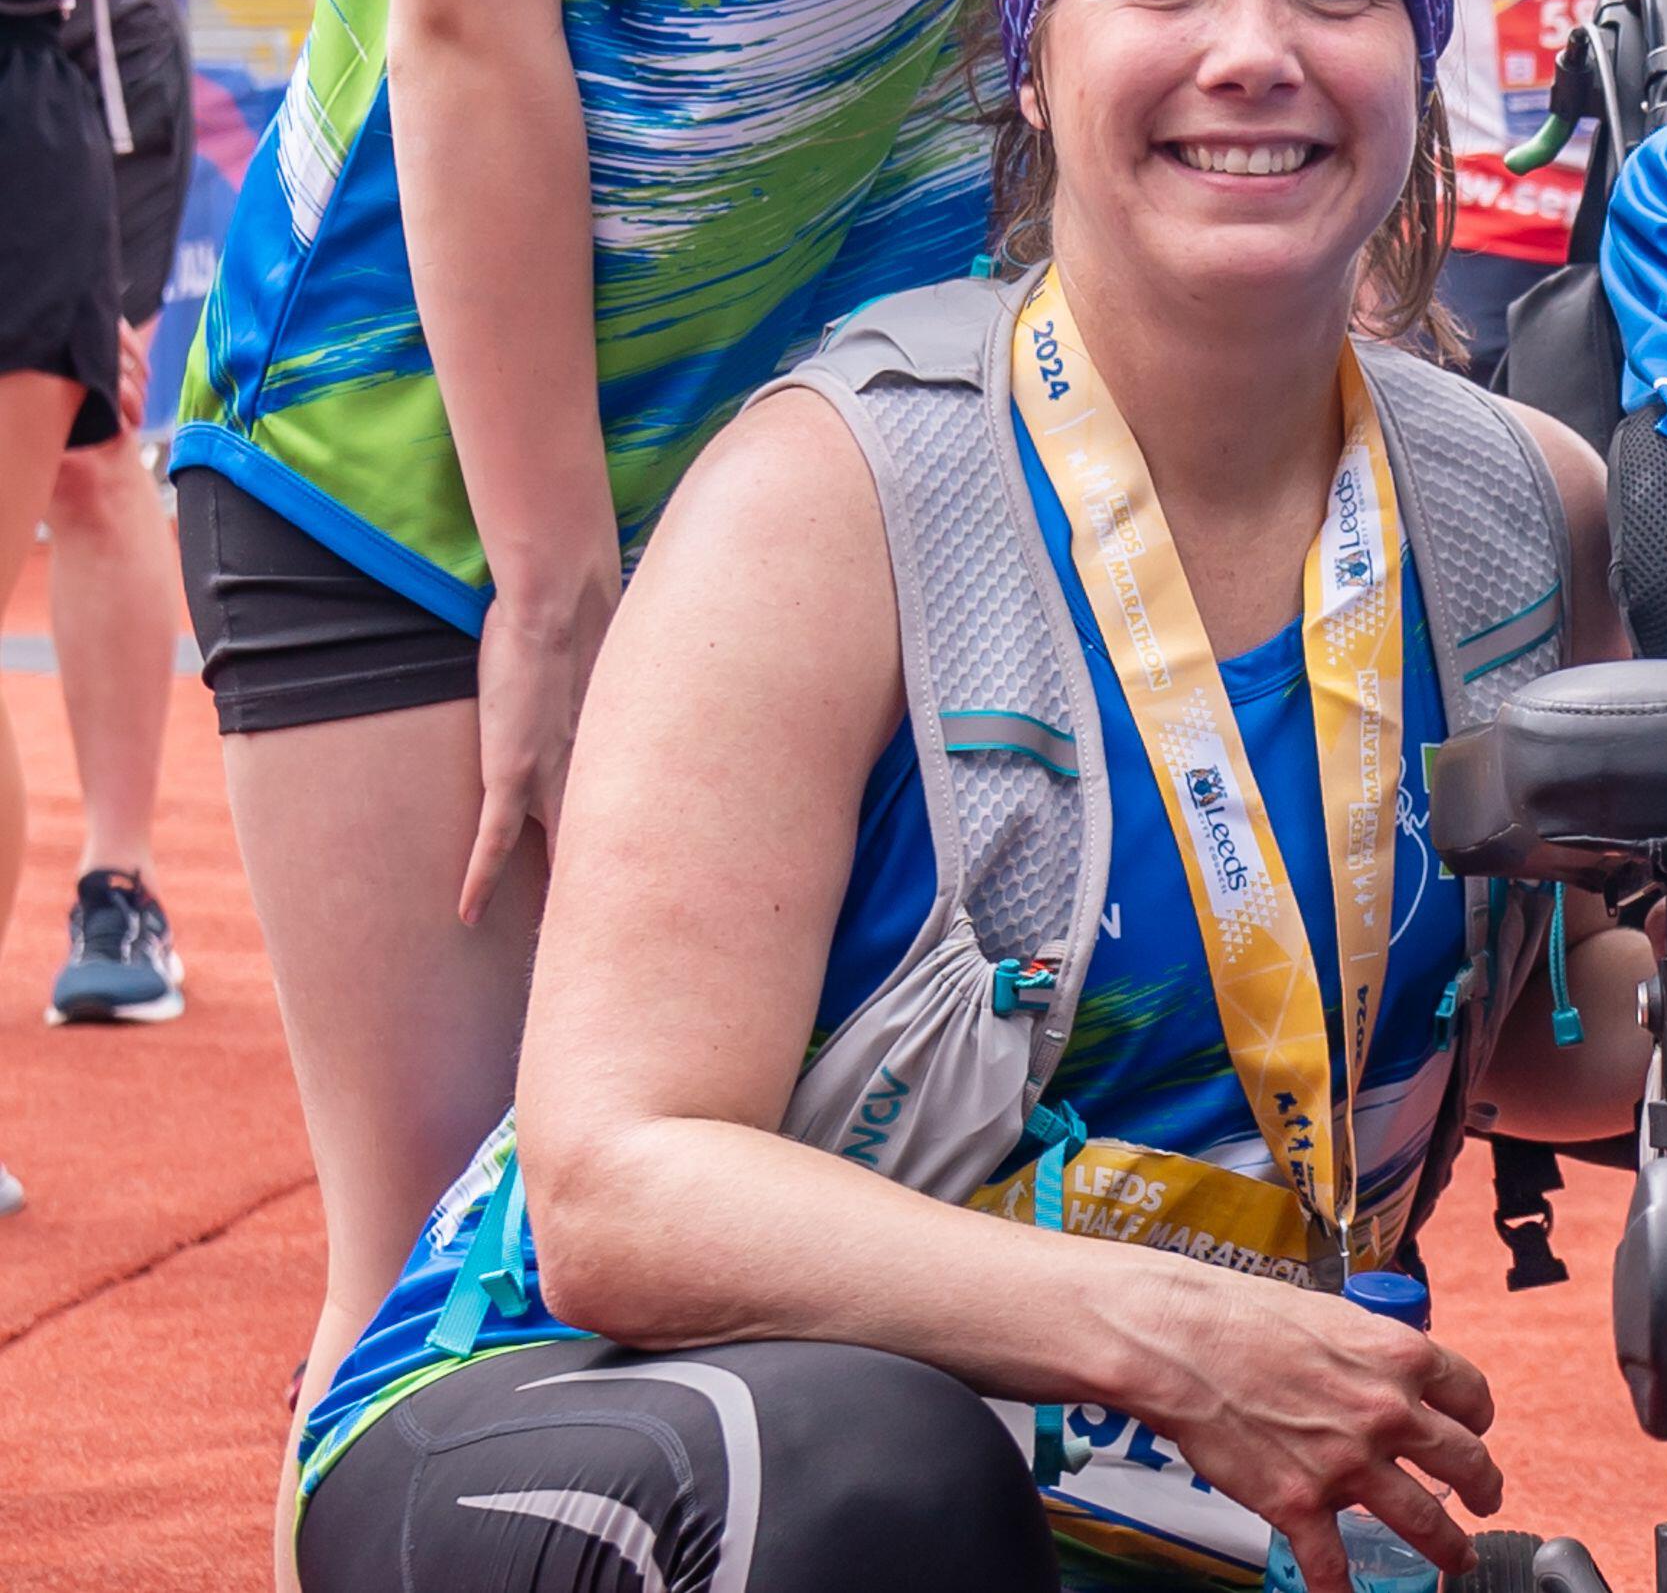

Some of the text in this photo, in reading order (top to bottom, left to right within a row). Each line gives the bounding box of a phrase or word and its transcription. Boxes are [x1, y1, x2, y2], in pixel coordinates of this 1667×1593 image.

[1033, 320, 1071, 401] 2024
[1108, 494, 1144, 555] LEEDS
[1334, 470, 1361, 551] Leeds
[1109, 559, 1169, 690] MARATHON
[1361, 672, 1381, 804] MARATHON
[1205, 806, 1249, 892] Leeds
[1355, 983, 1370, 1067] 2024
[1074, 1164, 1167, 1212] LEEDS
[1068, 1200, 1318, 1290] HALF MARATHON
